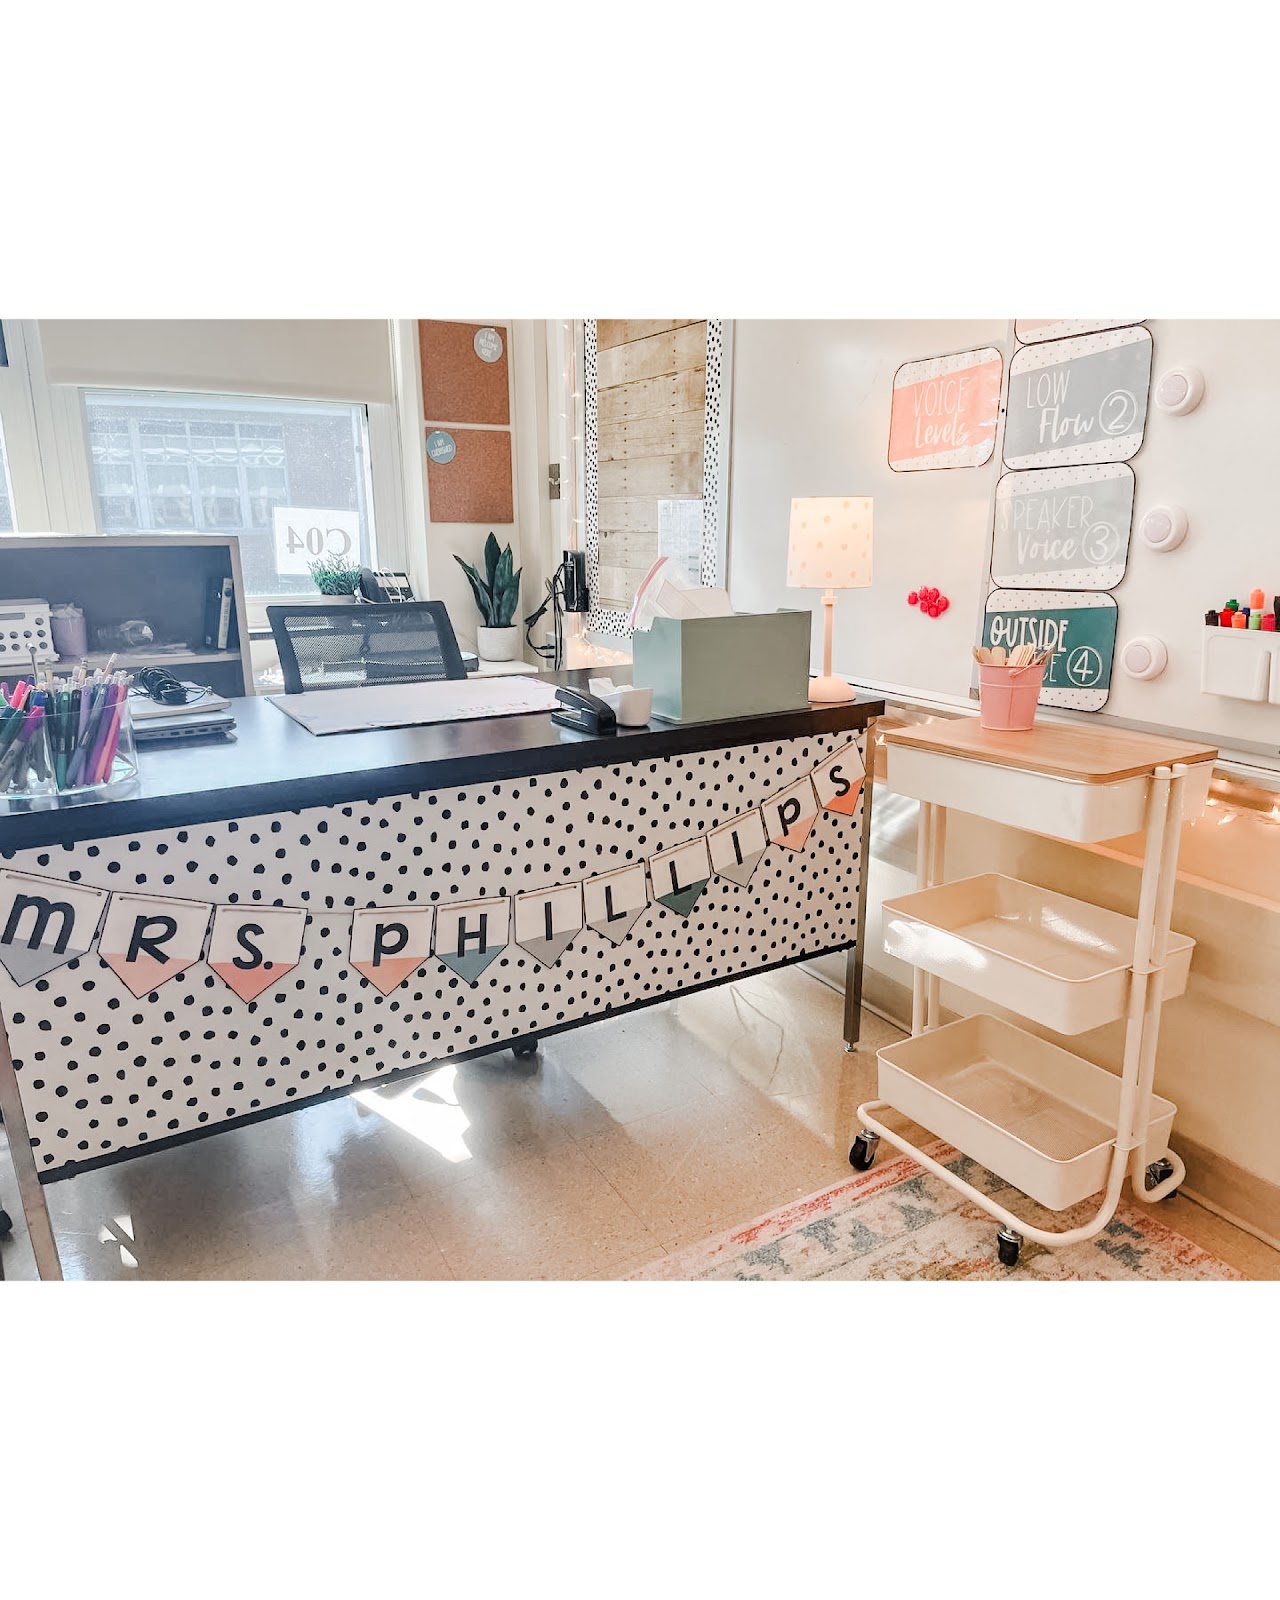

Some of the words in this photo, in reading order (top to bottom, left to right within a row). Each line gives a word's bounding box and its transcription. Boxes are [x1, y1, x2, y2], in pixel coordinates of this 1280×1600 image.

[913, 376, 971, 417] VOICE
[1026, 369, 1071, 409] LOW
[915, 413, 971, 449] Levels
[1039, 404, 1095, 444] Flow
[1106, 394, 1129, 432] 2
[999, 495, 1094, 532] SPEAKER
[1017, 532, 1079, 565] Voice
[1088, 523, 1112, 562] 3
[990, 615, 1069, 653] OUTSIDE
[1071, 648, 1096, 683] 4
